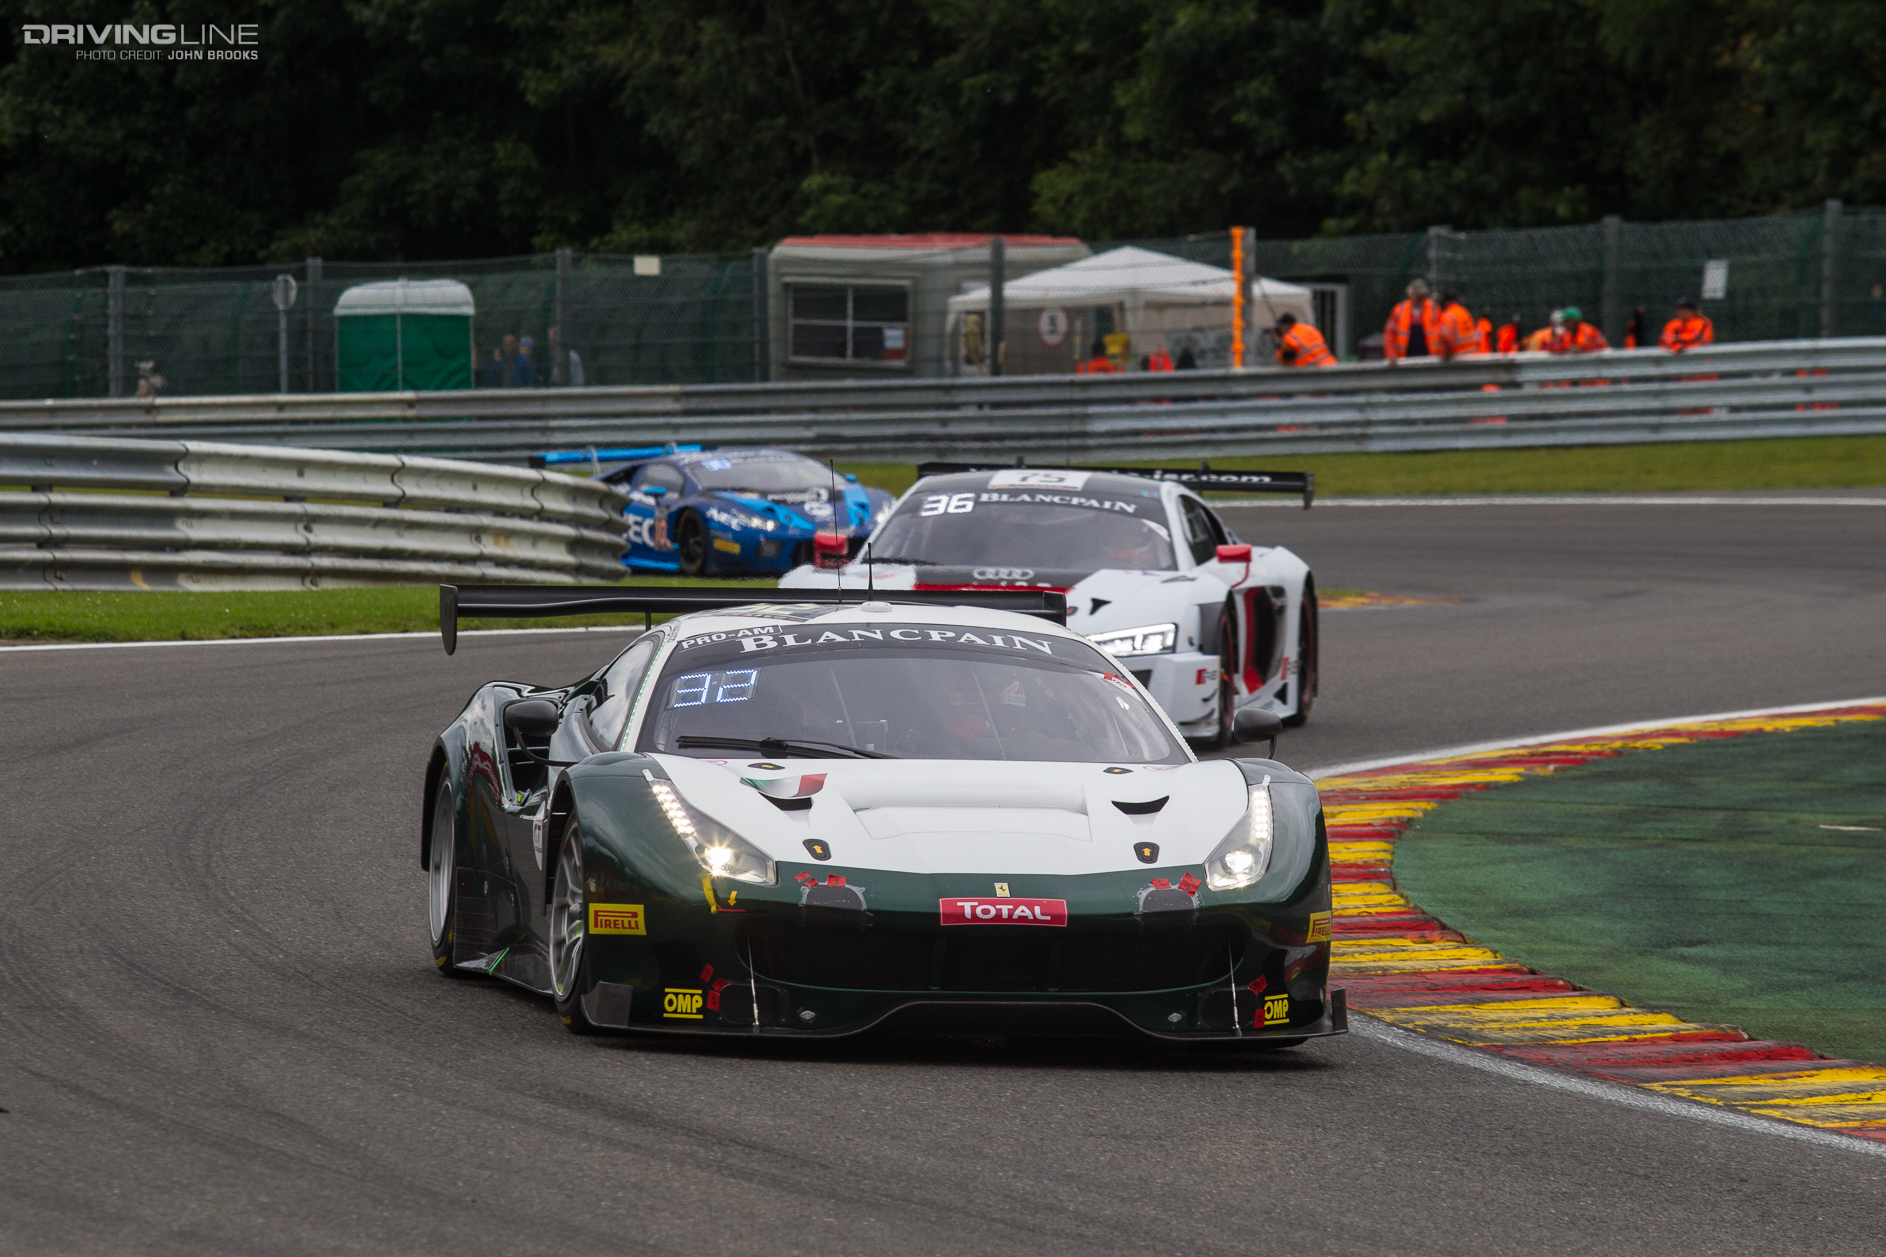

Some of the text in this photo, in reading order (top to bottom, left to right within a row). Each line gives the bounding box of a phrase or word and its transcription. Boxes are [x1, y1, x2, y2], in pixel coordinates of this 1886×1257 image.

[920, 492, 975, 516] 36
[976, 492, 1138, 514] BLANCPAIN
[681, 626, 775, 649] PRO-AM
[736, 628, 1053, 655] BLANCPAIN
[674, 669, 757, 707] 32
[594, 910, 639, 930] PIRELLI
[957, 902, 1052, 920] TOTAL
[664, 993, 703, 1014] OMP
[1264, 999, 1289, 1019] OMP
